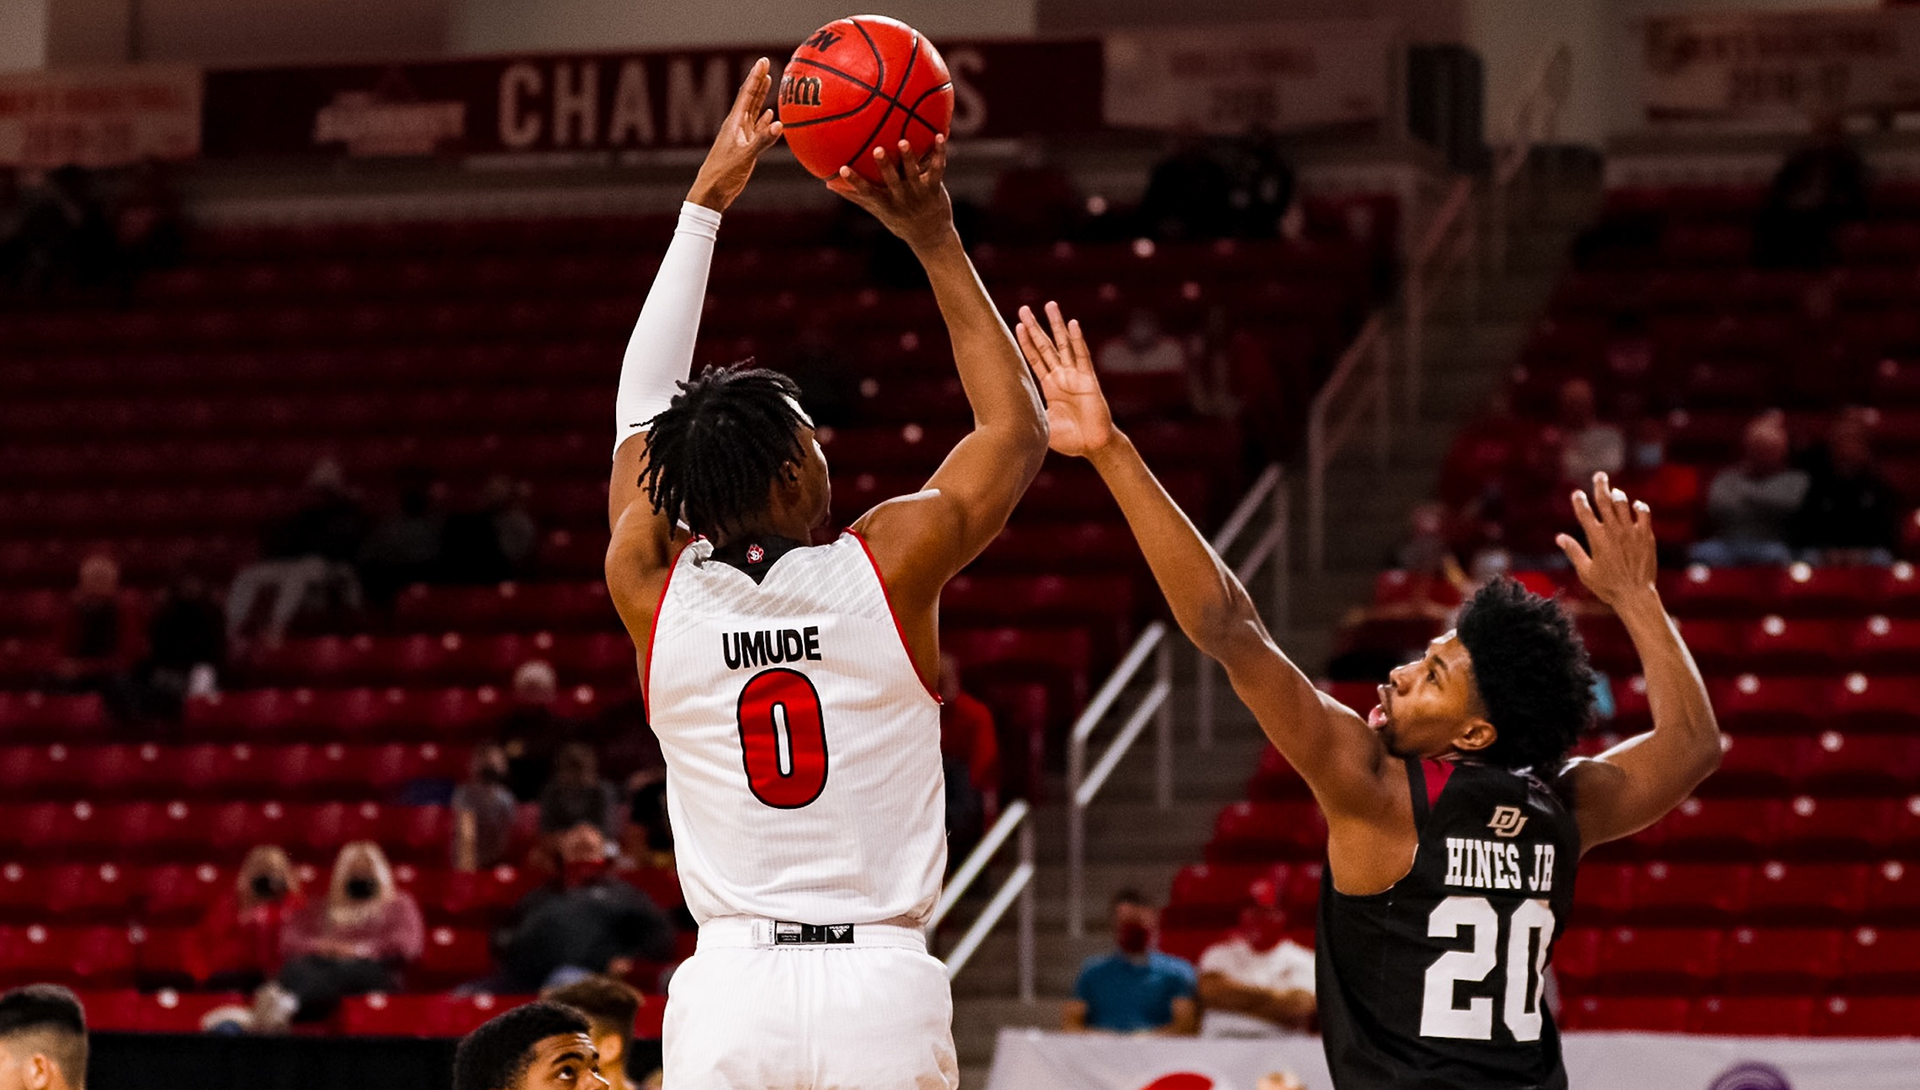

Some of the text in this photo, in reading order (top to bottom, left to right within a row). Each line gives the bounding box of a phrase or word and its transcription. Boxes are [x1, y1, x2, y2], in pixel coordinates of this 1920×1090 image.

[500, 52, 988, 148] CHAMS
[722, 625, 822, 670] UMUDE
[737, 667, 829, 810] 0
[1444, 837, 1522, 890] HINES
[1420, 896, 1555, 1042] 20
